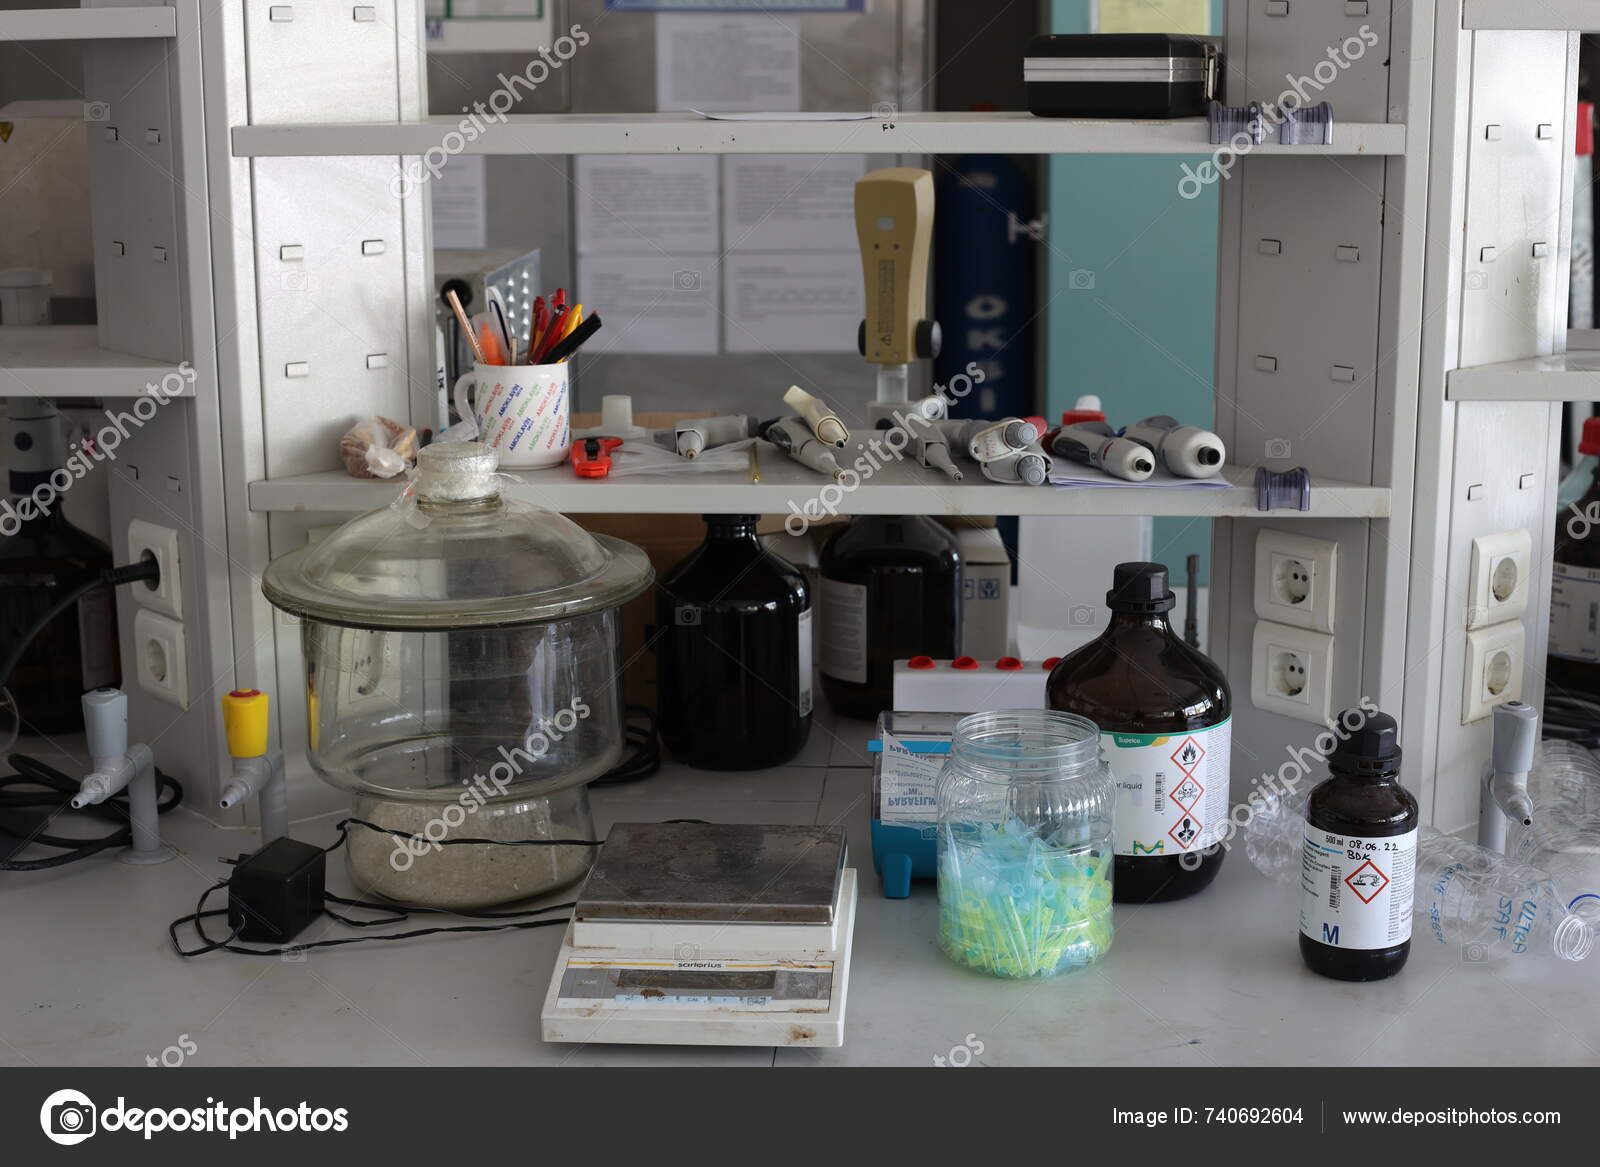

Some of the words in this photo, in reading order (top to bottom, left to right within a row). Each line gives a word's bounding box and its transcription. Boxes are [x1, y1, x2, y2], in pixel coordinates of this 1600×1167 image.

[498, 383, 520, 417] AMOKLAVIN
[509, 417, 531, 451] AMOKLAVIN
[1122, 781, 1143, 790] liquid
[1325, 835, 1336, 846] 500
[1336, 838, 1344, 847] ml
[1346, 850, 1372, 862] BDK
[1491, 896, 1513, 941] SAF
[1511, 900, 1537, 954] ULTRA
[1321, 922, 1341, 945] M
[677, 961, 722, 969] sartorius
